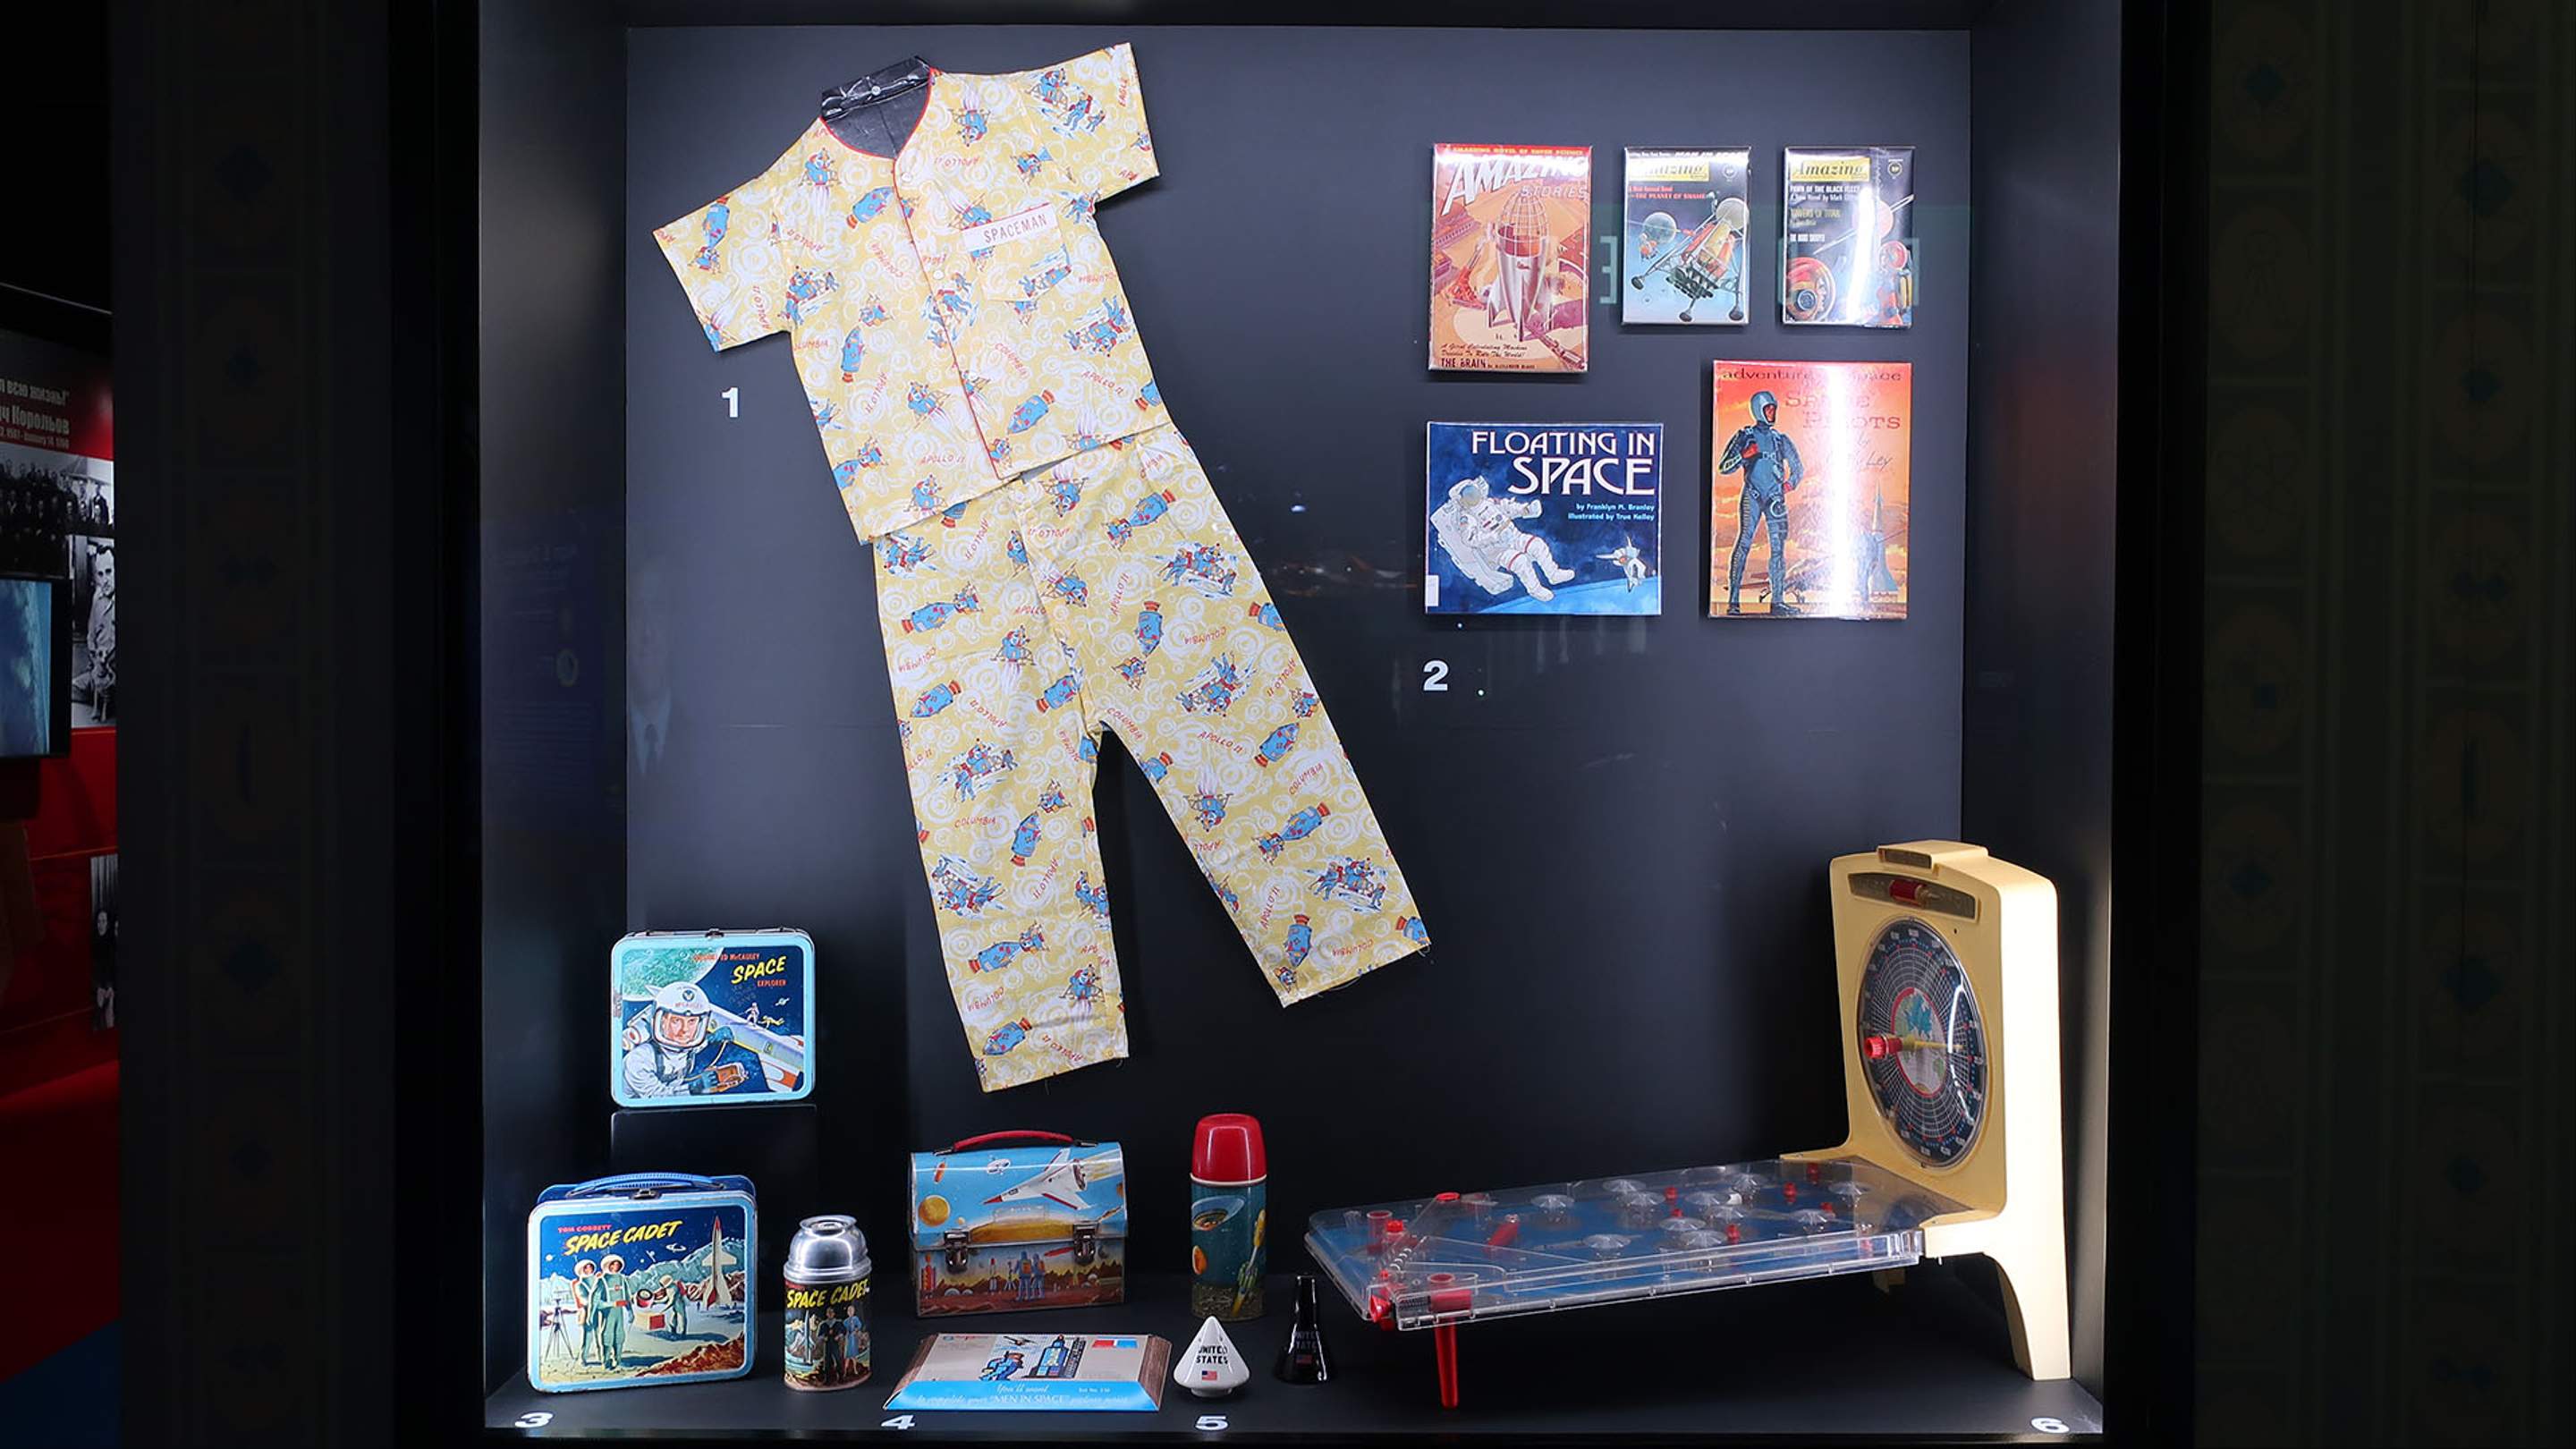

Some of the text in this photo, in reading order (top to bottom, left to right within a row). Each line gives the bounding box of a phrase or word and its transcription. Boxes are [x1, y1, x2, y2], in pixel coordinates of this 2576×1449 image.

[1521, 184, 1589, 200] STORIES
[983, 213, 1048, 244] SPACEMAN
[1441, 358, 1456, 368] THE
[1081, 370, 1115, 389] APOLLO
[721, 386, 739, 418] 1
[1471, 431, 1656, 455] FLOATING IN
[1507, 456, 1656, 496] SPACE
[1576, 503, 1585, 511] by
[1586, 503, 1616, 511] Franklyn
[1568, 513, 1604, 521] Illustrated
[1606, 513, 1614, 521] by
[1616, 513, 1631, 521] True
[970, 517, 988, 553] APOLLO
[1110, 583, 1126, 616] APOLLO
[1183, 626, 1227, 645] COLUMBIA
[1275, 657, 1297, 689] APOLLO
[1422, 660, 1450, 692] 2
[1106, 707, 1143, 741] COLUMBIA
[1197, 730, 1234, 749] APOLLO
[1288, 762, 1325, 795] COLUMBIA
[953, 816, 997, 828] COLUMBIA
[1040, 858, 1059, 891] APOLLO
[1260, 895, 1276, 930] APOLLO
[731, 955, 787, 985] SPACE
[757, 979, 788, 987] EXPLORER
[558, 1225, 575, 1233] TOM
[564, 1219, 684, 1257] SPACE CADET
[787, 1288, 828, 1309] SPACE
[830, 1277, 870, 1305] CADET
[1196, 1355, 1228, 1365] STATES
[1021, 1394, 1032, 1403] IN
[514, 1411, 554, 1428] 3
[881, 1414, 915, 1429] 4
[1195, 1415, 1229, 1431] 5
[2030, 1417, 2071, 1434] 6
